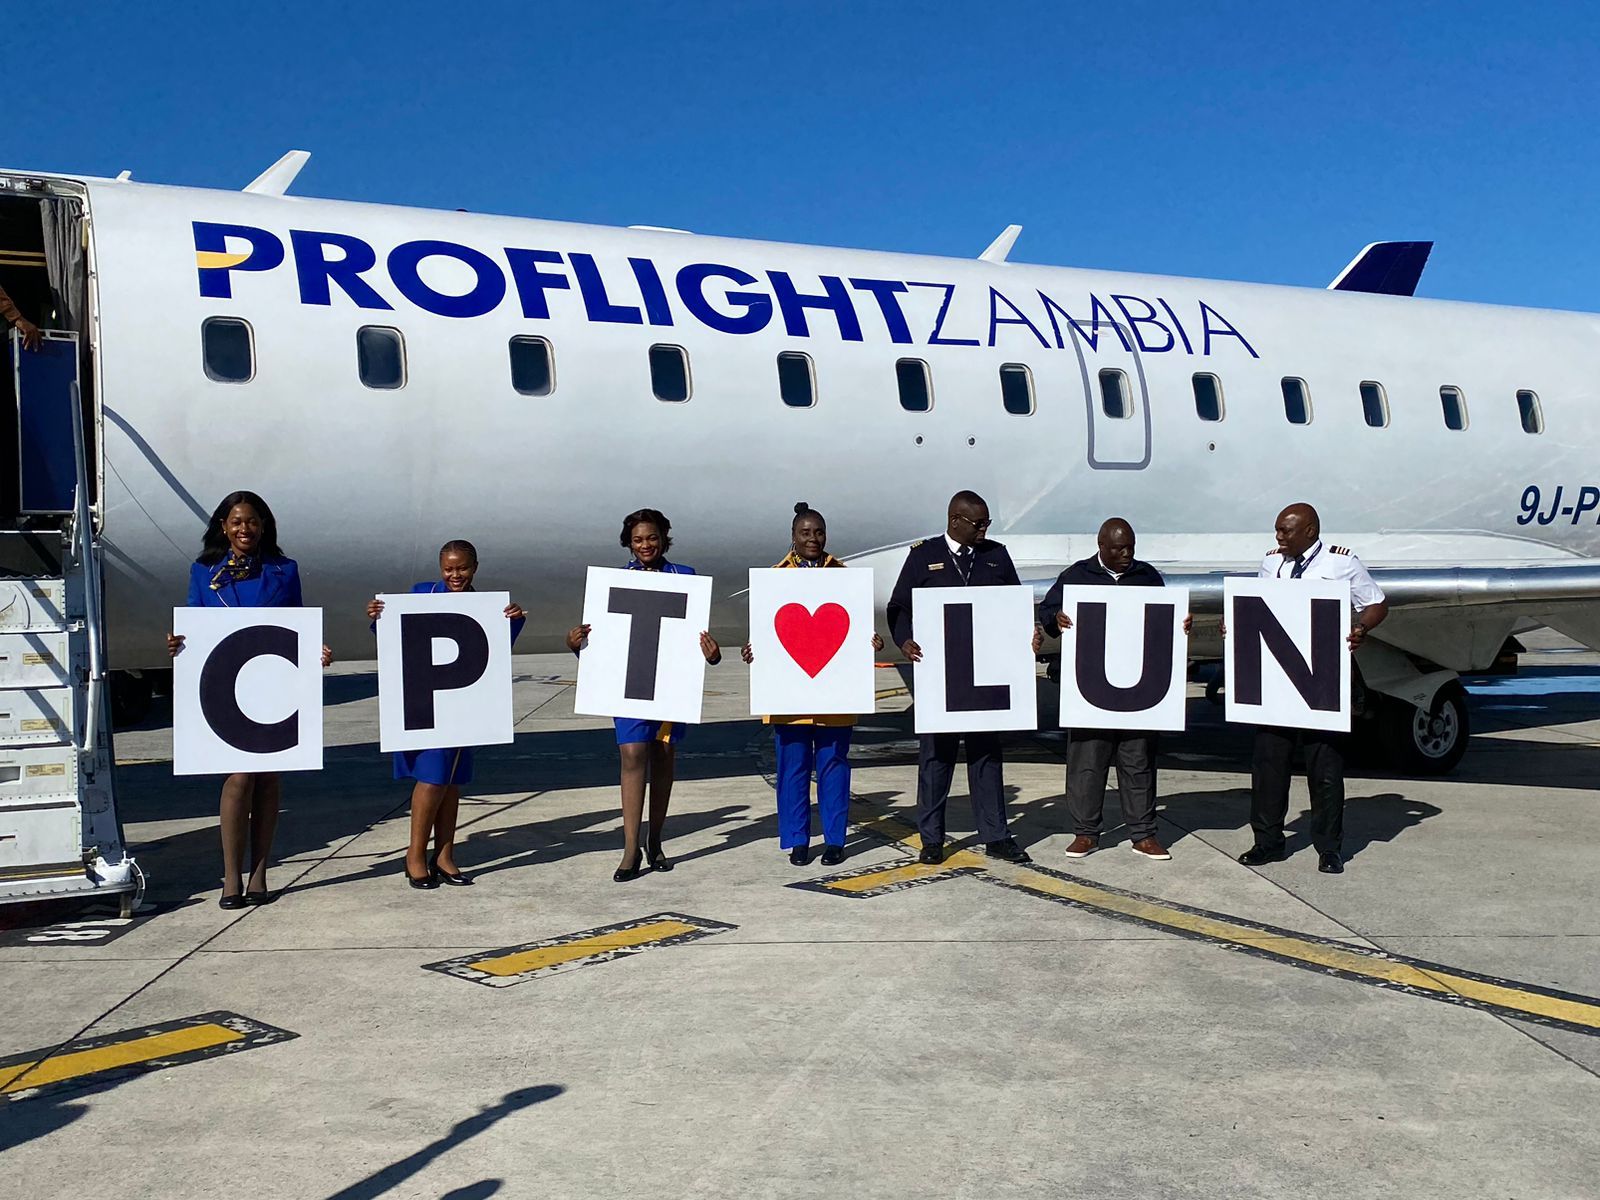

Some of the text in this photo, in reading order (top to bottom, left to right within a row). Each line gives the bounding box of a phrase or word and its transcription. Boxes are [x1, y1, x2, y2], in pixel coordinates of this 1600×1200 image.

[1516, 485, 1600, 525] 9J-P
[200, 587, 1340, 753] C P T L U N
